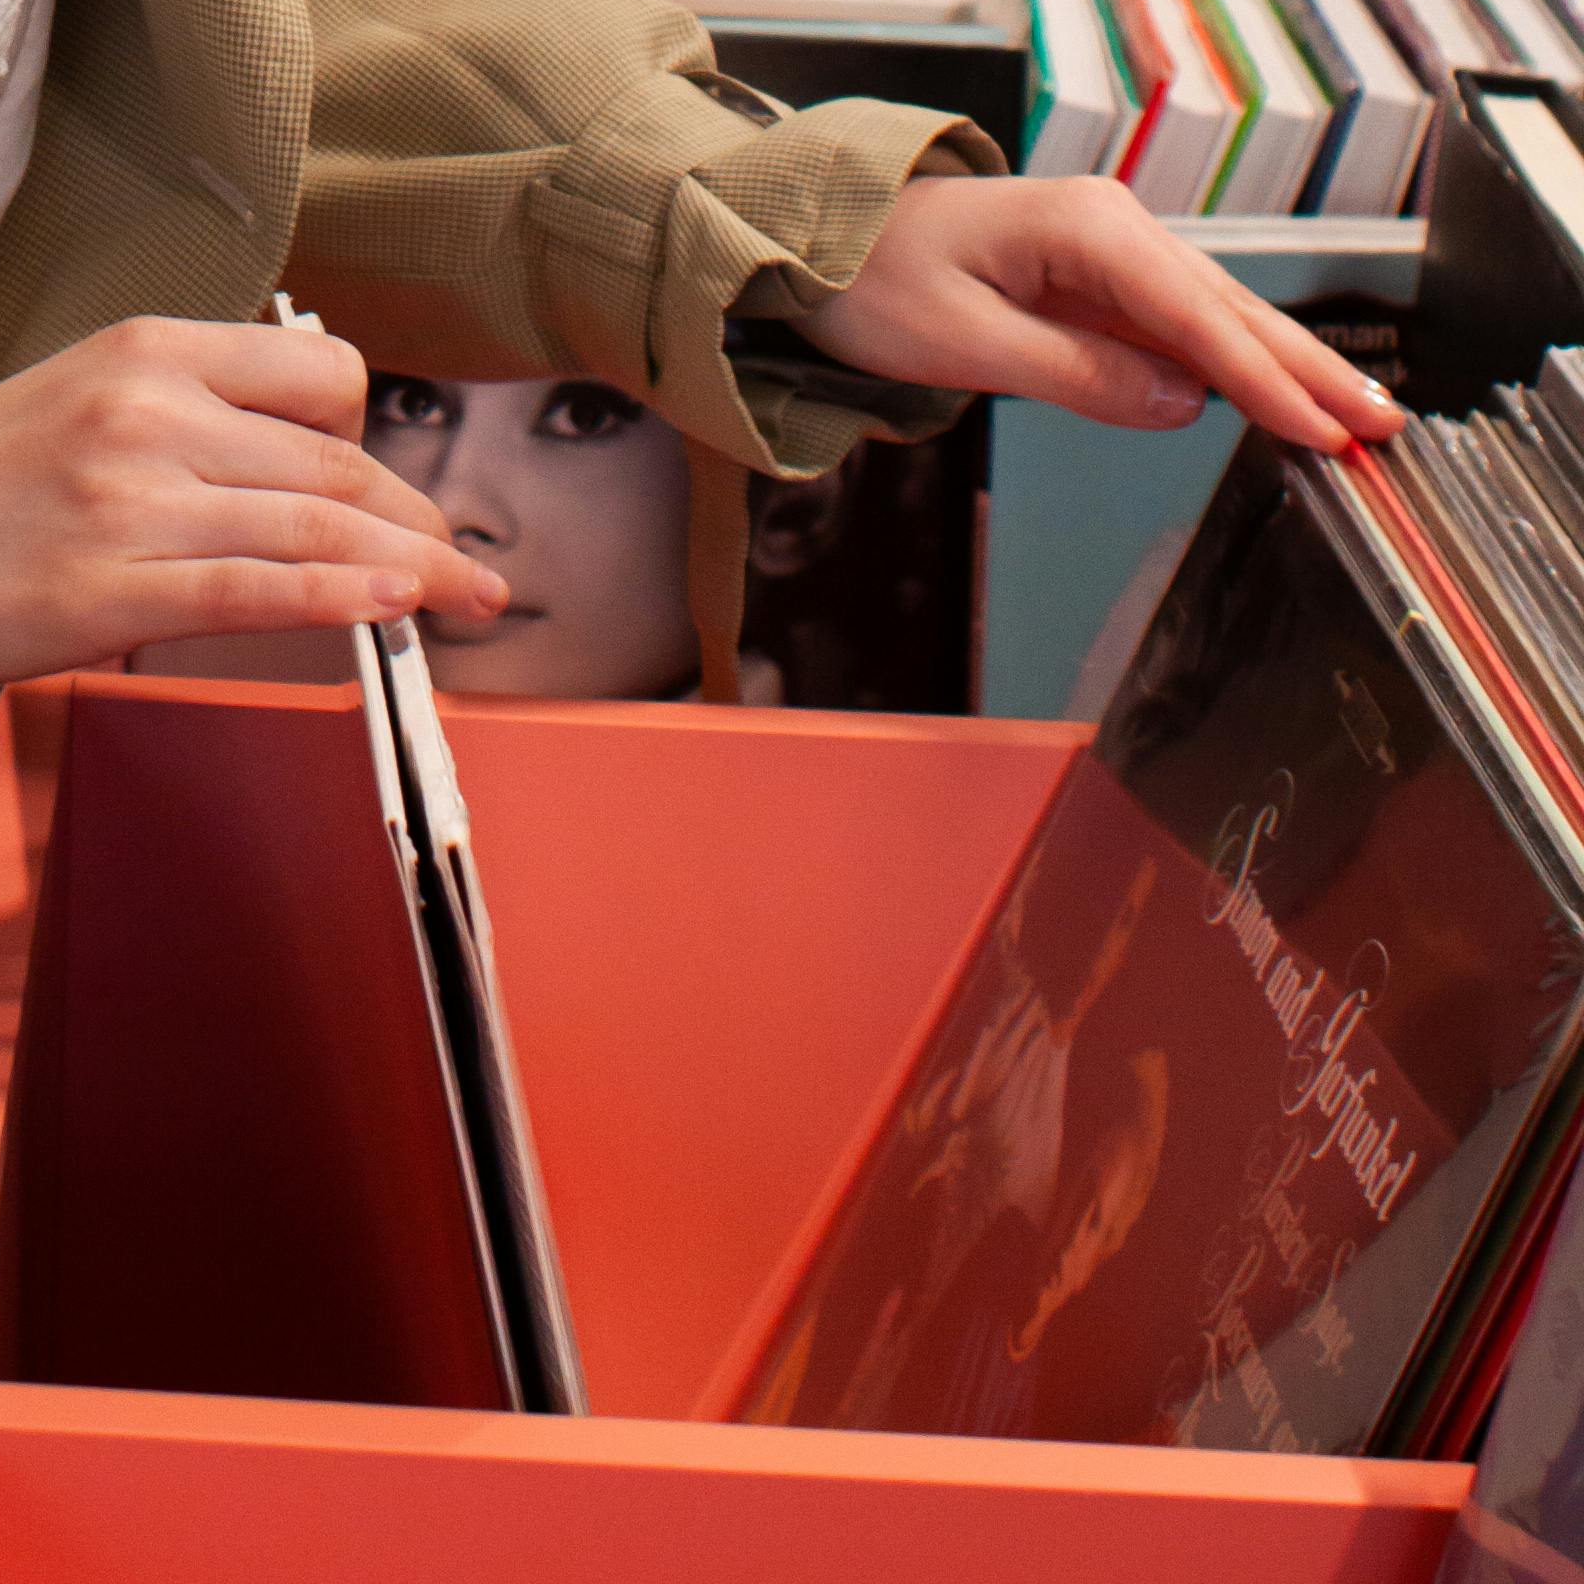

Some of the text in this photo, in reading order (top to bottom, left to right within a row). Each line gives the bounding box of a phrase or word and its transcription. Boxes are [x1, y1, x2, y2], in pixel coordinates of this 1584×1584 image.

[1205, 770, 1416, 1223] Simon and Garfunkel
